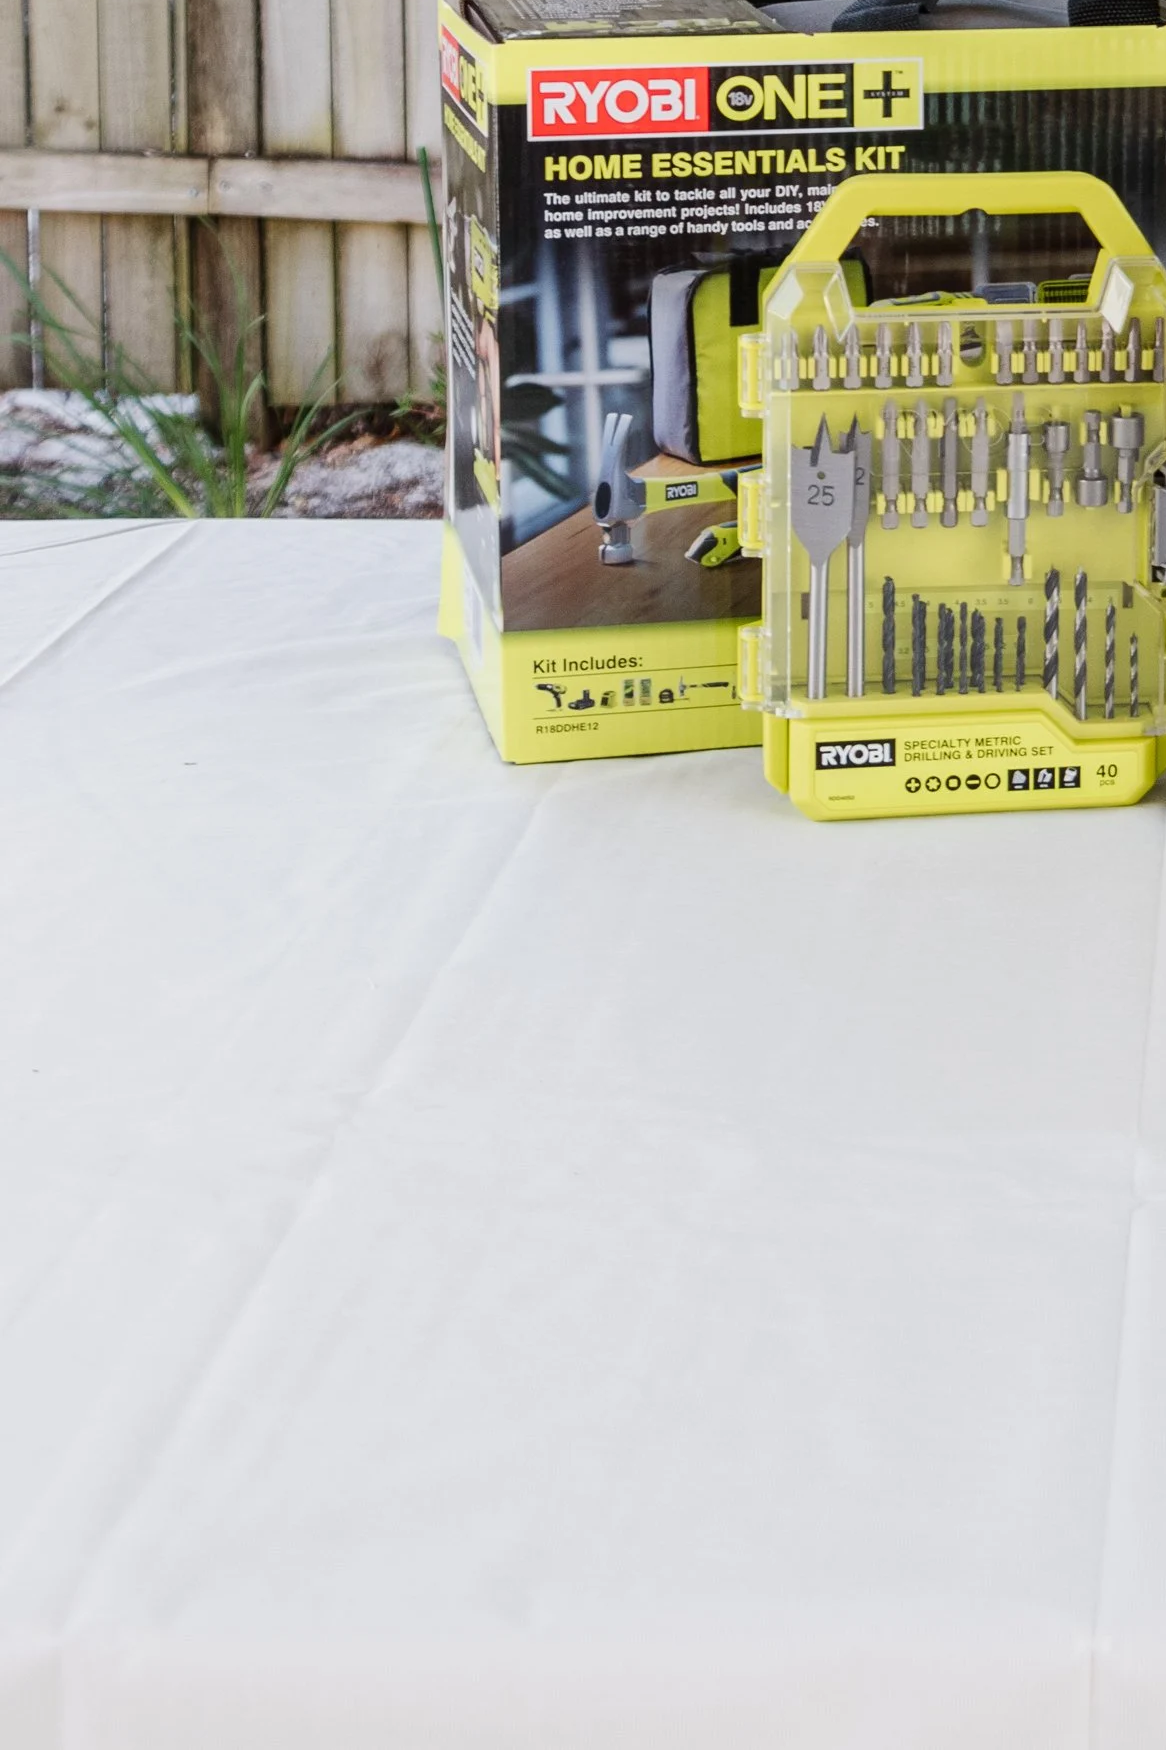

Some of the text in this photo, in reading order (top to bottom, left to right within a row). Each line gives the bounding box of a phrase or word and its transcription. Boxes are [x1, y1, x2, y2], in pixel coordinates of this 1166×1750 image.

[539, 78, 697, 125] RYOBI
[544, 145, 906, 181] HOME ESSENTIALS KIT
[544, 192, 571, 205] The
[575, 191, 630, 205] ultimate
[634, 190, 652, 202] kit
[655, 190, 670, 202] to
[674, 188, 715, 201] tackle
[719, 187, 736, 200] all
[740, 188, 771, 201] your
[775, 185, 803, 198] DIY,
[544, 210, 583, 222] home
[588, 206, 677, 222] improvement
[681, 203, 740, 219] projects!
[745, 202, 801, 215] Includes
[544, 227, 561, 239] as
[564, 225, 592, 238] well
[595, 225, 612, 237] as
[615, 226, 624, 236] a
[627, 224, 666, 237] range
[669, 222, 684, 234] of
[687, 220, 728, 235] handy
[731, 219, 765, 232] tools
[768, 218, 794, 231] and
[667, 483, 697, 499] RYOBI
[808, 484, 835, 507] 25
[533, 655, 643, 674] Kit Includes:
[536, 722, 599, 734] R18DDHE12
[904, 736, 1022, 750] SPECIALTY METRIC
[904, 746, 1054, 762] DRILLING & DRIVING SET
[1096, 764, 1118, 778] 40
